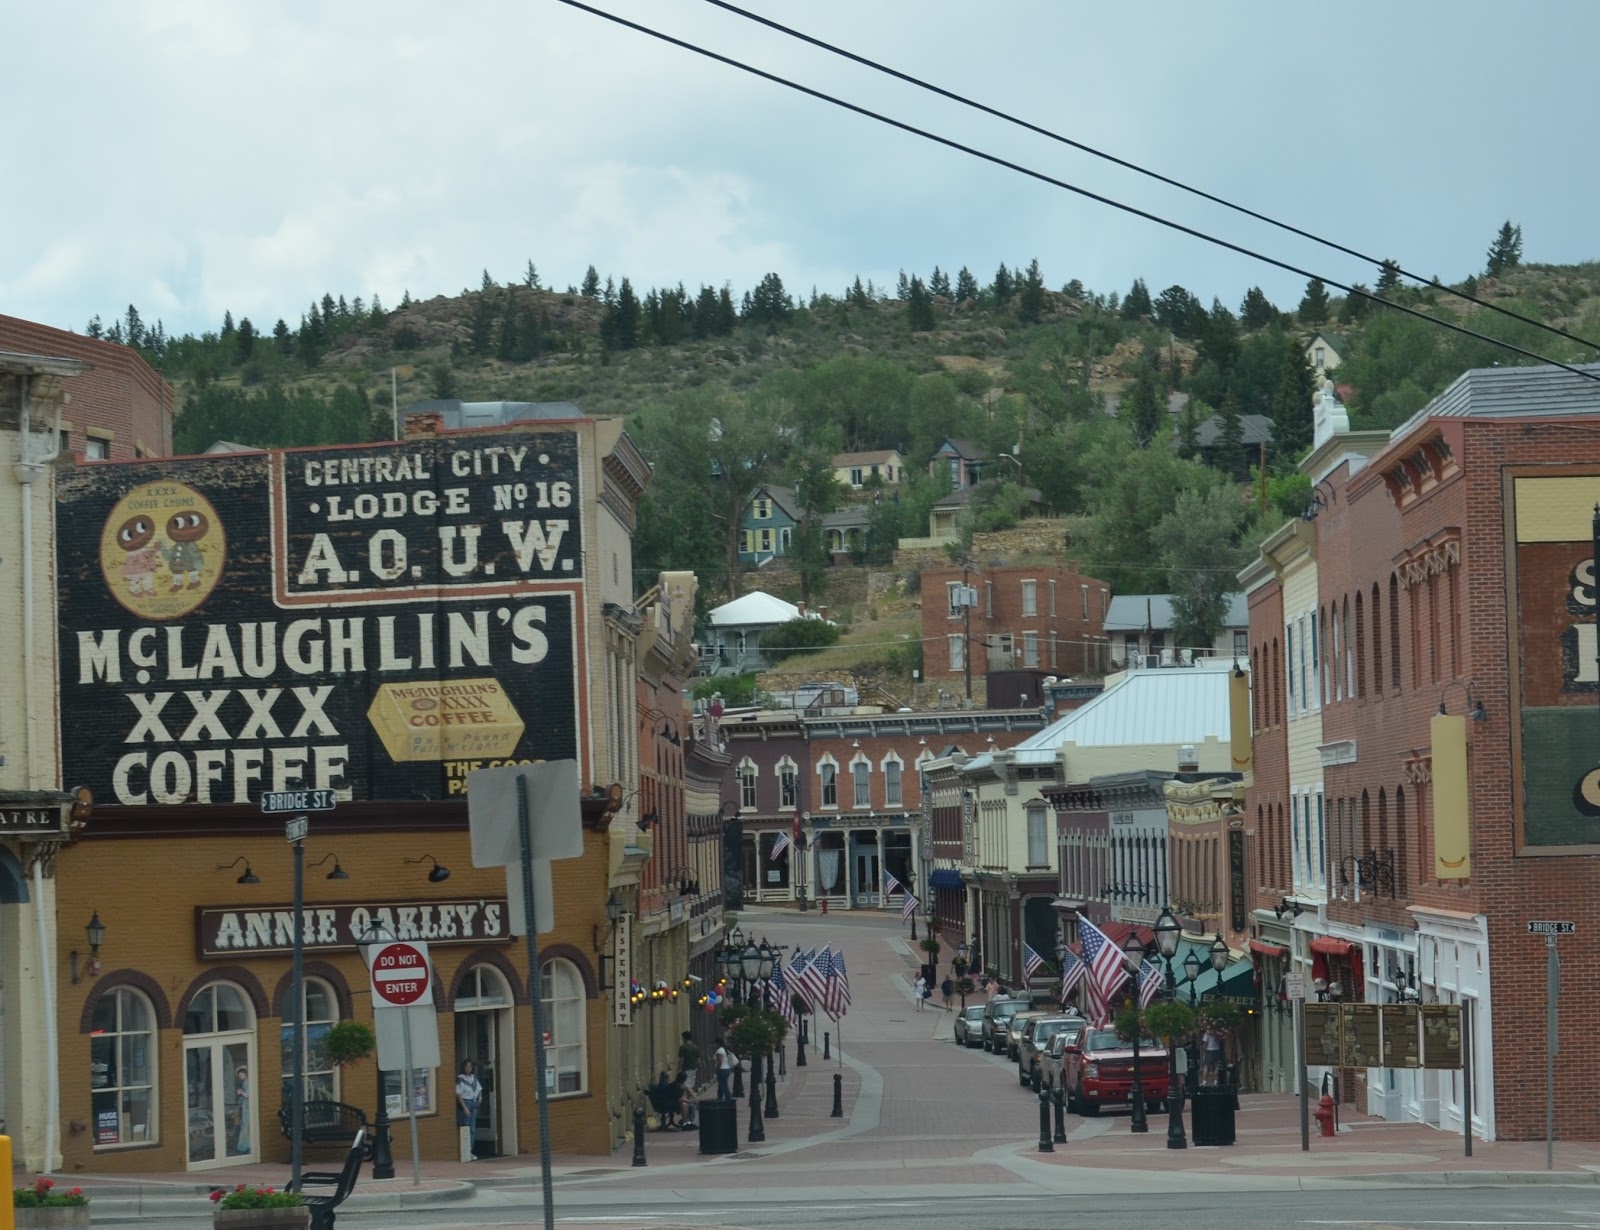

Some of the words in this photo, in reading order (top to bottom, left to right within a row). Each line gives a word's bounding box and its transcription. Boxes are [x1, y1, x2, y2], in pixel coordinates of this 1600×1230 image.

[305, 454, 430, 486] CENTRAL
[452, 447, 528, 477] CITY
[128, 500, 159, 510] COFFEE
[327, 488, 470, 522] LODGE
[536, 481, 571, 508] 16
[440, 695, 490, 710] XXXX
[124, 685, 340, 743] XXXX
[410, 711, 497, 727] COFFEE
[463, 732, 510, 743] Pound
[412, 744, 440, 753] Full
[447, 742, 499, 752] Weight
[112, 744, 353, 805] COFFEE
[444, 761, 482, 777] THE
[269, 792, 309, 810] BRIDGE
[313, 791, 328, 808] ST
[923, 795, 931, 856] CENTURY
[964, 796, 973, 863] CENTURY
[215, 908, 337, 949] ANNIE
[349, 899, 501, 940] OAKLEY'S
[1533, 923, 1558, 932] BRIDGE
[1561, 923, 1572, 933] ST.
[381, 956, 395, 967] DO
[399, 954, 417, 965] NOT
[618, 917, 627, 1021] DISPENSARY
[385, 982, 418, 994] ENTER
[1203, 994, 1216, 1002] EZ
[98, 1111, 118, 1120] HUGE
